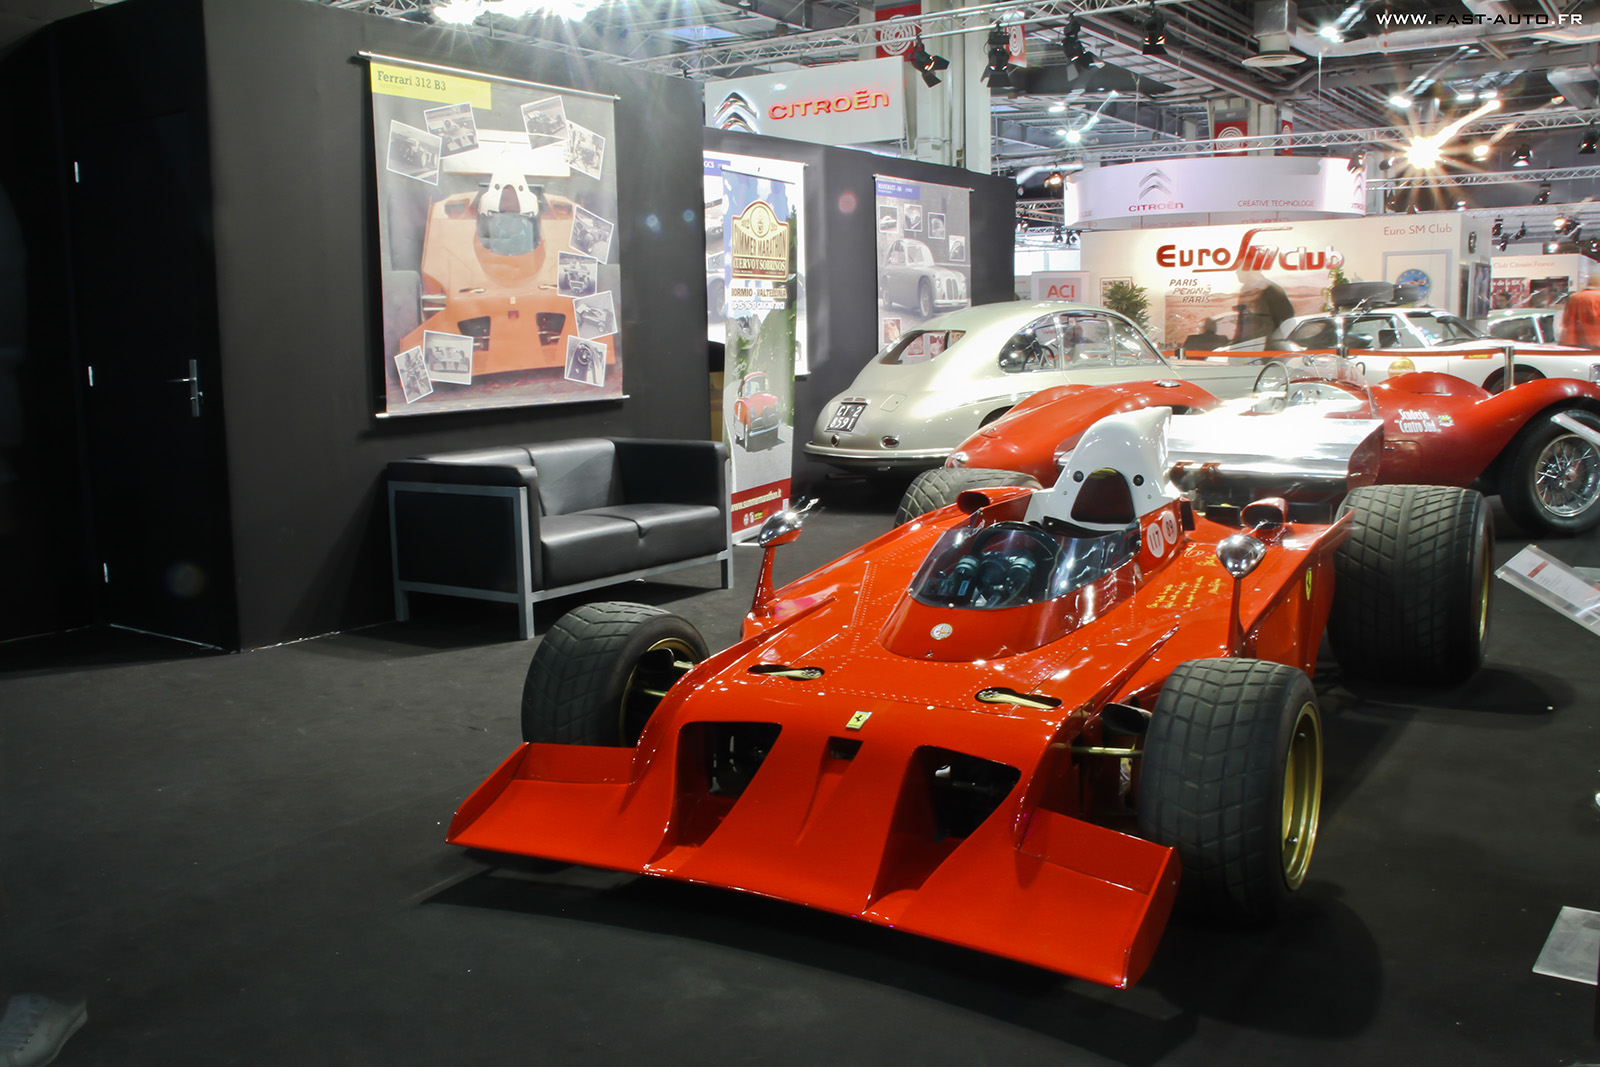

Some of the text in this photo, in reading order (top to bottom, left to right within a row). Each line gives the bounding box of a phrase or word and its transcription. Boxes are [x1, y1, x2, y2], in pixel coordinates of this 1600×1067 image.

[377, 70, 412, 86] Ferrari
[415, 77, 431, 89] 312
[434, 81, 446, 91] B3
[768, 89, 889, 120] CITROËN
[1128, 201, 1184, 212] CITROËN
[1271, 200, 1315, 208] TECHNOLOGIE
[1384, 224, 1453, 236] Euro SM Club
[733, 223, 786, 259] SUMMER MARATHON
[1156, 244, 1231, 267] Euro
[1169, 278, 1198, 287] PARIS
[731, 288, 753, 297] BORMIO
[1046, 285, 1075, 298] ACI
[1182, 295, 1210, 304] PARIS
[837, 405, 862, 417] CT 2
[1398, 408, 1430, 420] Scuderia
[830, 417, 855, 429] 8591
[1394, 419, 1439, 433] Centro Sud
[1149, 530, 1161, 551] 117
